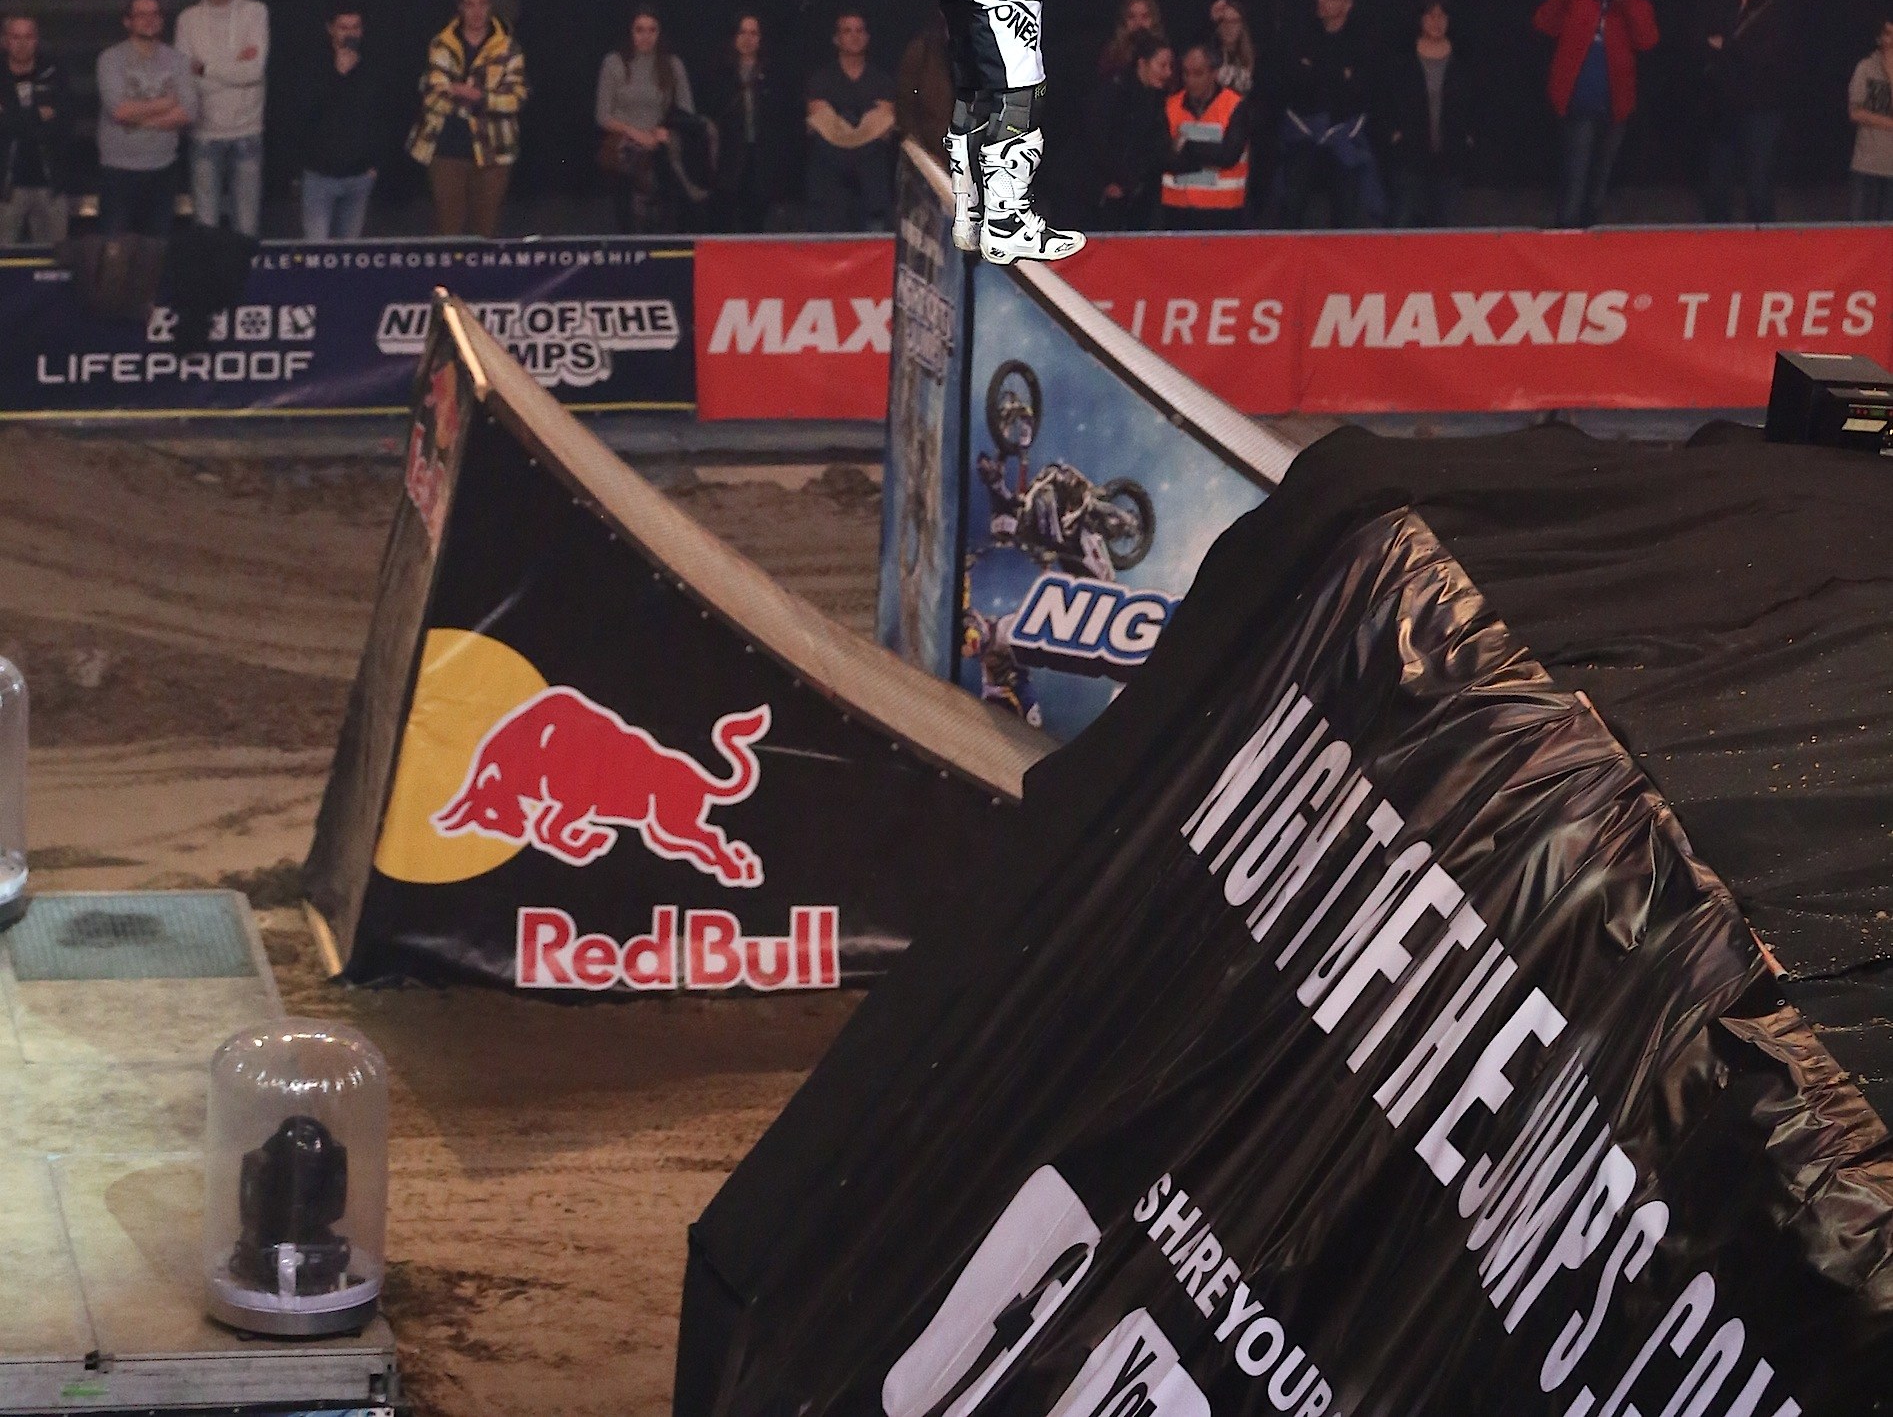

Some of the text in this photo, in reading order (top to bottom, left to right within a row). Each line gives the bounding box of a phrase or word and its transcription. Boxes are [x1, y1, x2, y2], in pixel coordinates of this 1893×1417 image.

[304, 252, 454, 270] MOTOCROSS
[465, 249, 648, 268] CHAMPIONSHIP
[528, 306, 578, 334] OF
[591, 305, 673, 333] THE
[1678, 289, 1877, 340] TIRES
[36, 351, 314, 384] LIFEPROOF
[515, 904, 840, 990] Red Bull
